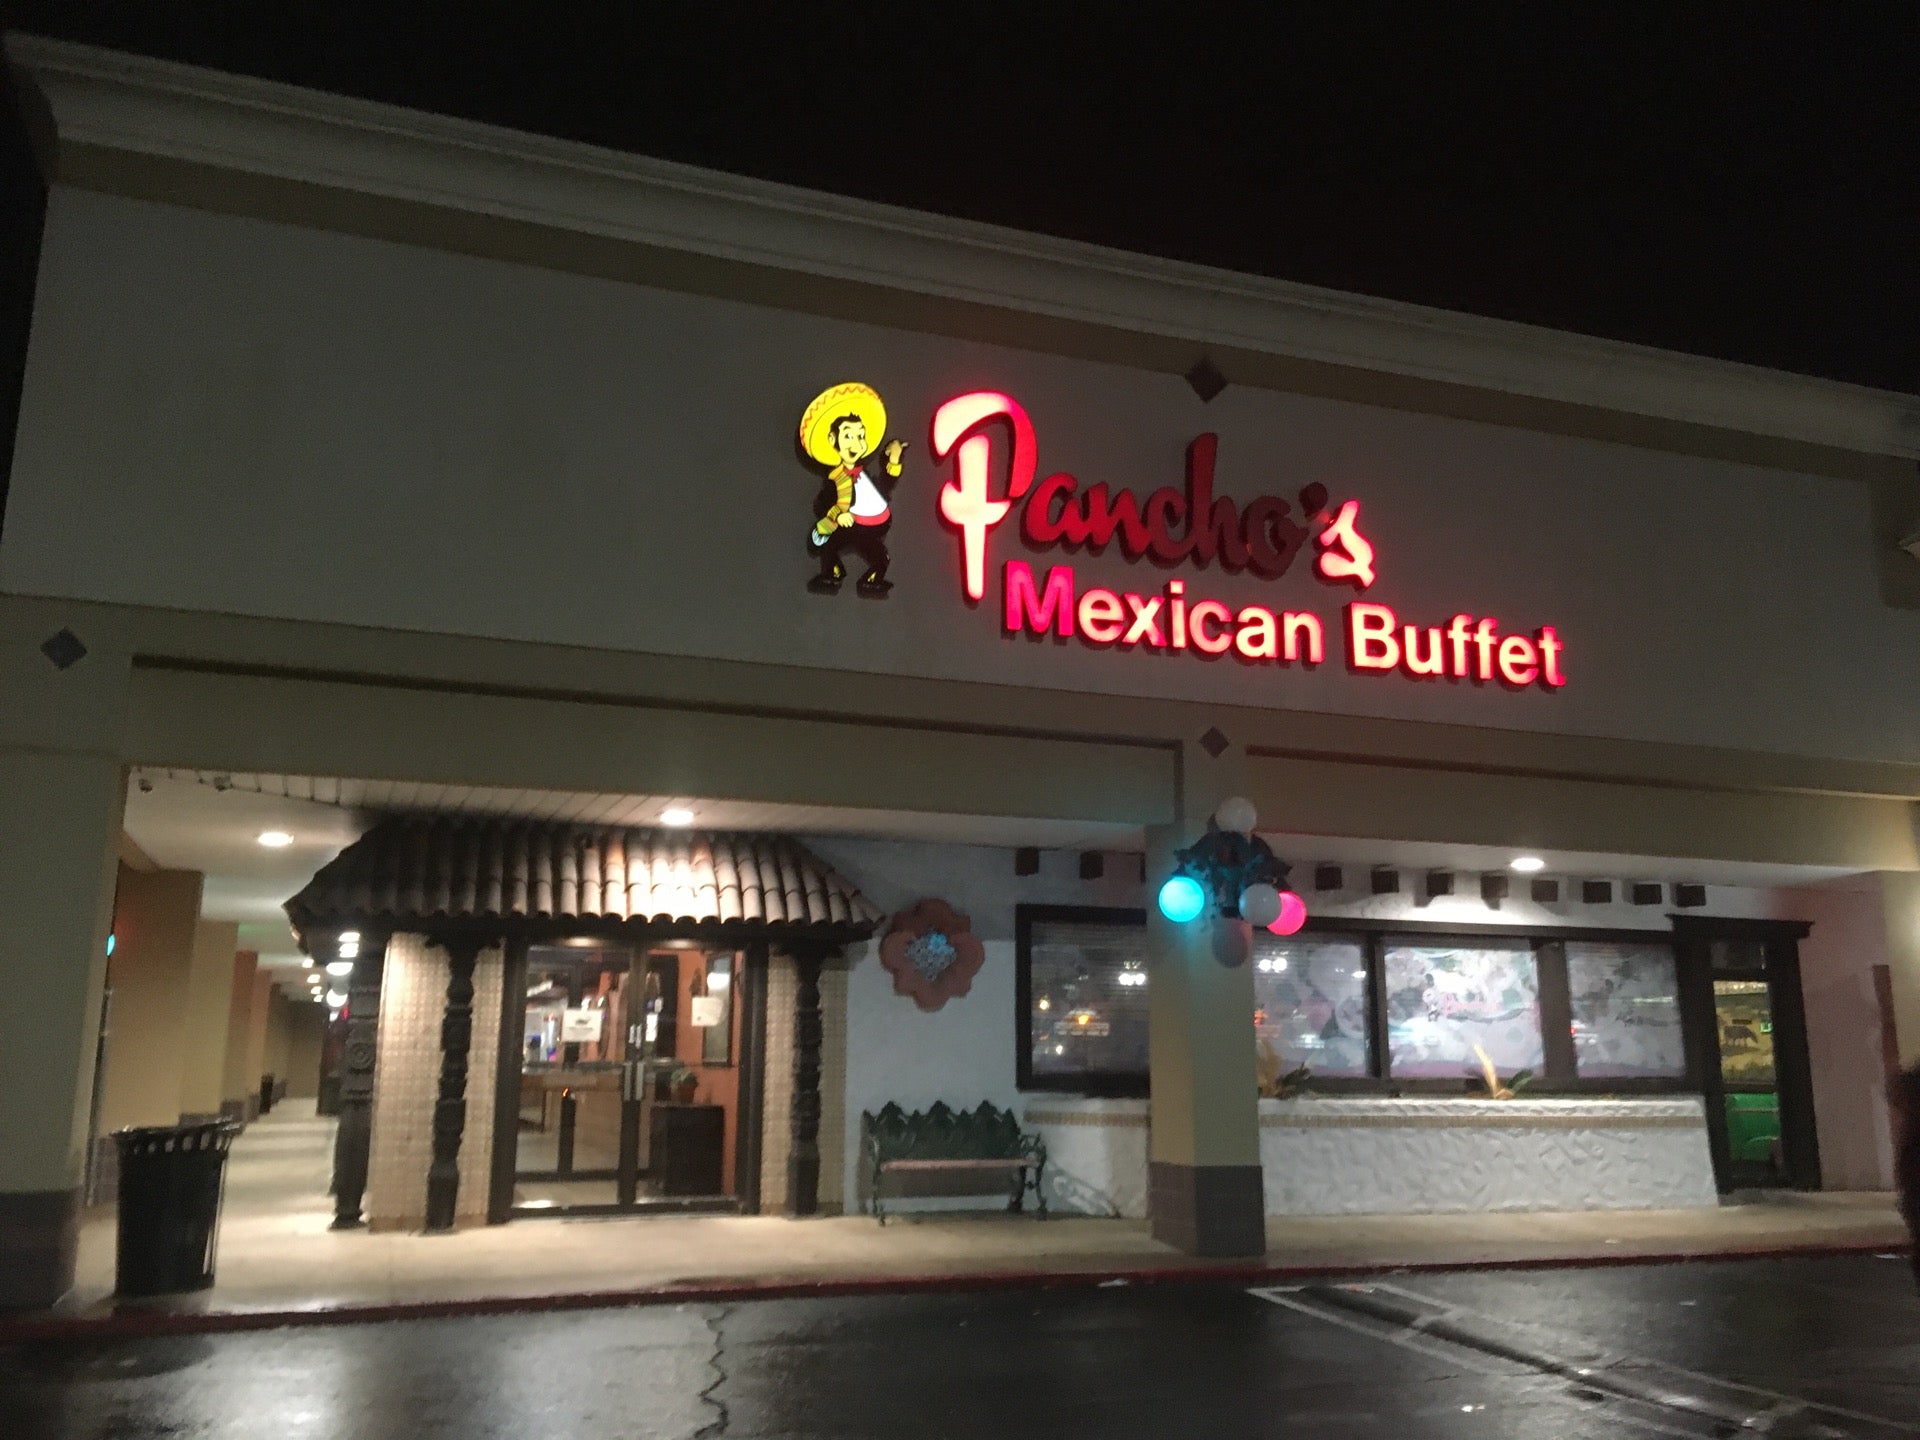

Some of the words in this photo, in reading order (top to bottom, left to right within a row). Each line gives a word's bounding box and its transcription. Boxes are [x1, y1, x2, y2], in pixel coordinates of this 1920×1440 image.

[932, 391, 1375, 600] Pancho's
[1003, 559, 1325, 664] Mexican
[1347, 602, 1566, 688] Buffet
